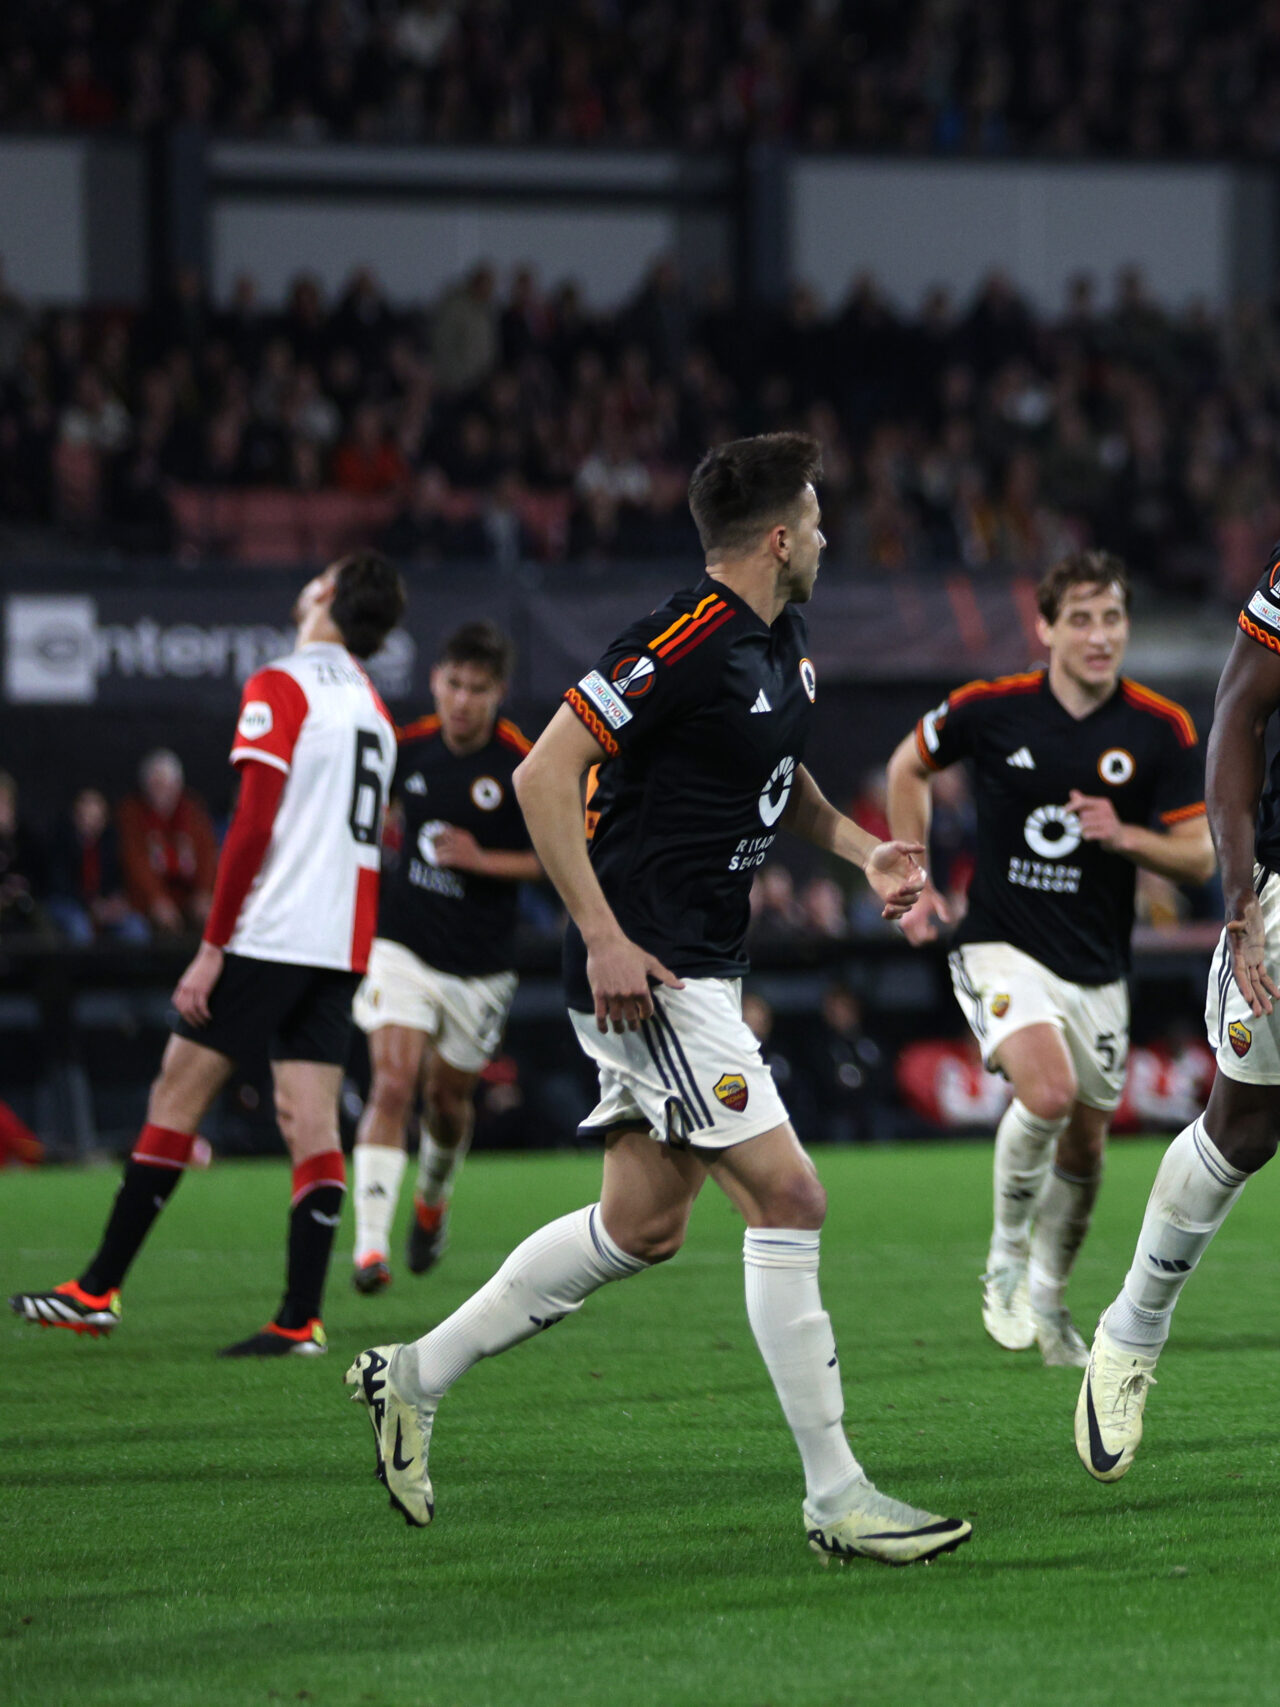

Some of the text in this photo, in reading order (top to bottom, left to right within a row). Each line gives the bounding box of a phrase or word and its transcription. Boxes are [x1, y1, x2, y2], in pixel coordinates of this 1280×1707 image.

[349, 728, 383, 845] 6
[735, 833, 776, 854] RIYAD
[1009, 856, 1081, 880] RIYADH
[1008, 869, 1079, 894] SEASON
